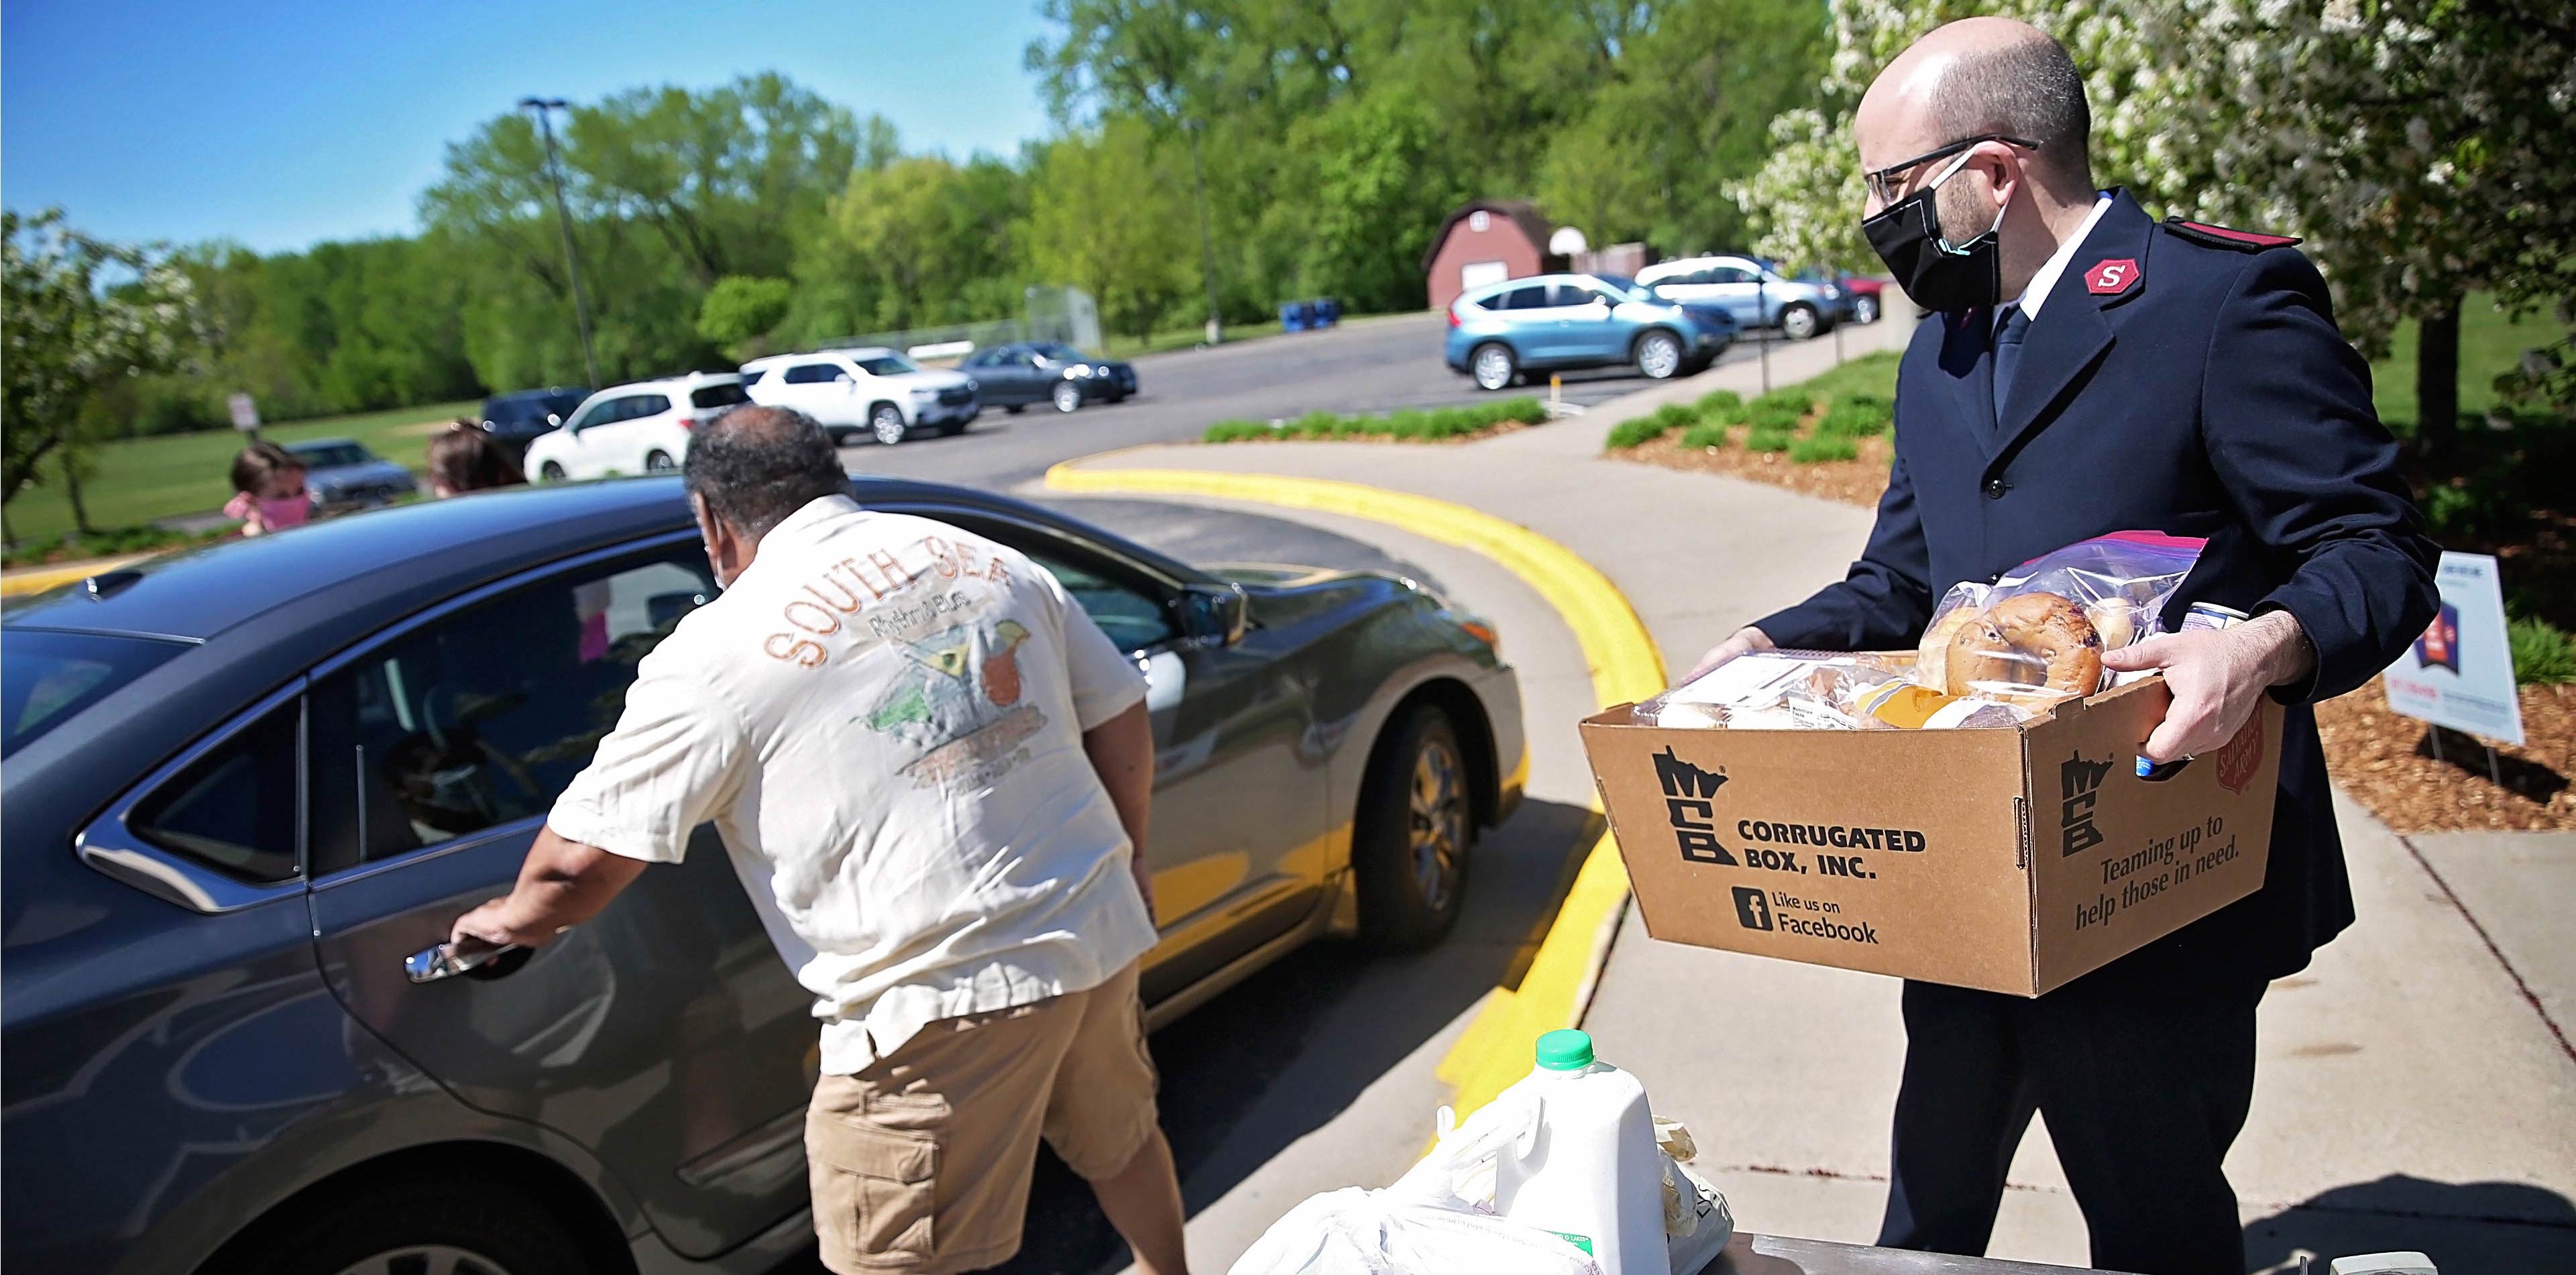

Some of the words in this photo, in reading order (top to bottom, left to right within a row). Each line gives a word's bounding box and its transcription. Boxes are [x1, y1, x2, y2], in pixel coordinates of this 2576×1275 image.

[2098, 265, 2126, 287] S
[763, 548, 917, 667] SOUTH
[2233, 731, 2259, 785] ARMY
[1738, 820, 1926, 852] CORRUGATED
[2101, 836, 2175, 885] Teaming
[2180, 828, 2201, 854] up
[2206, 816, 2223, 836] to
[1744, 848, 1807, 875] BOX,
[1817, 854, 1877, 879] INC.
[2076, 893, 2116, 931] help
[2122, 873, 2169, 909] those
[2174, 858, 2190, 885] in
[2195, 834, 2239, 876] need.
[1771, 891, 1801, 909] Like
[1803, 899, 1820, 912] us
[1822, 901, 1841, 914] on
[1777, 913, 1879, 944] Facebook
